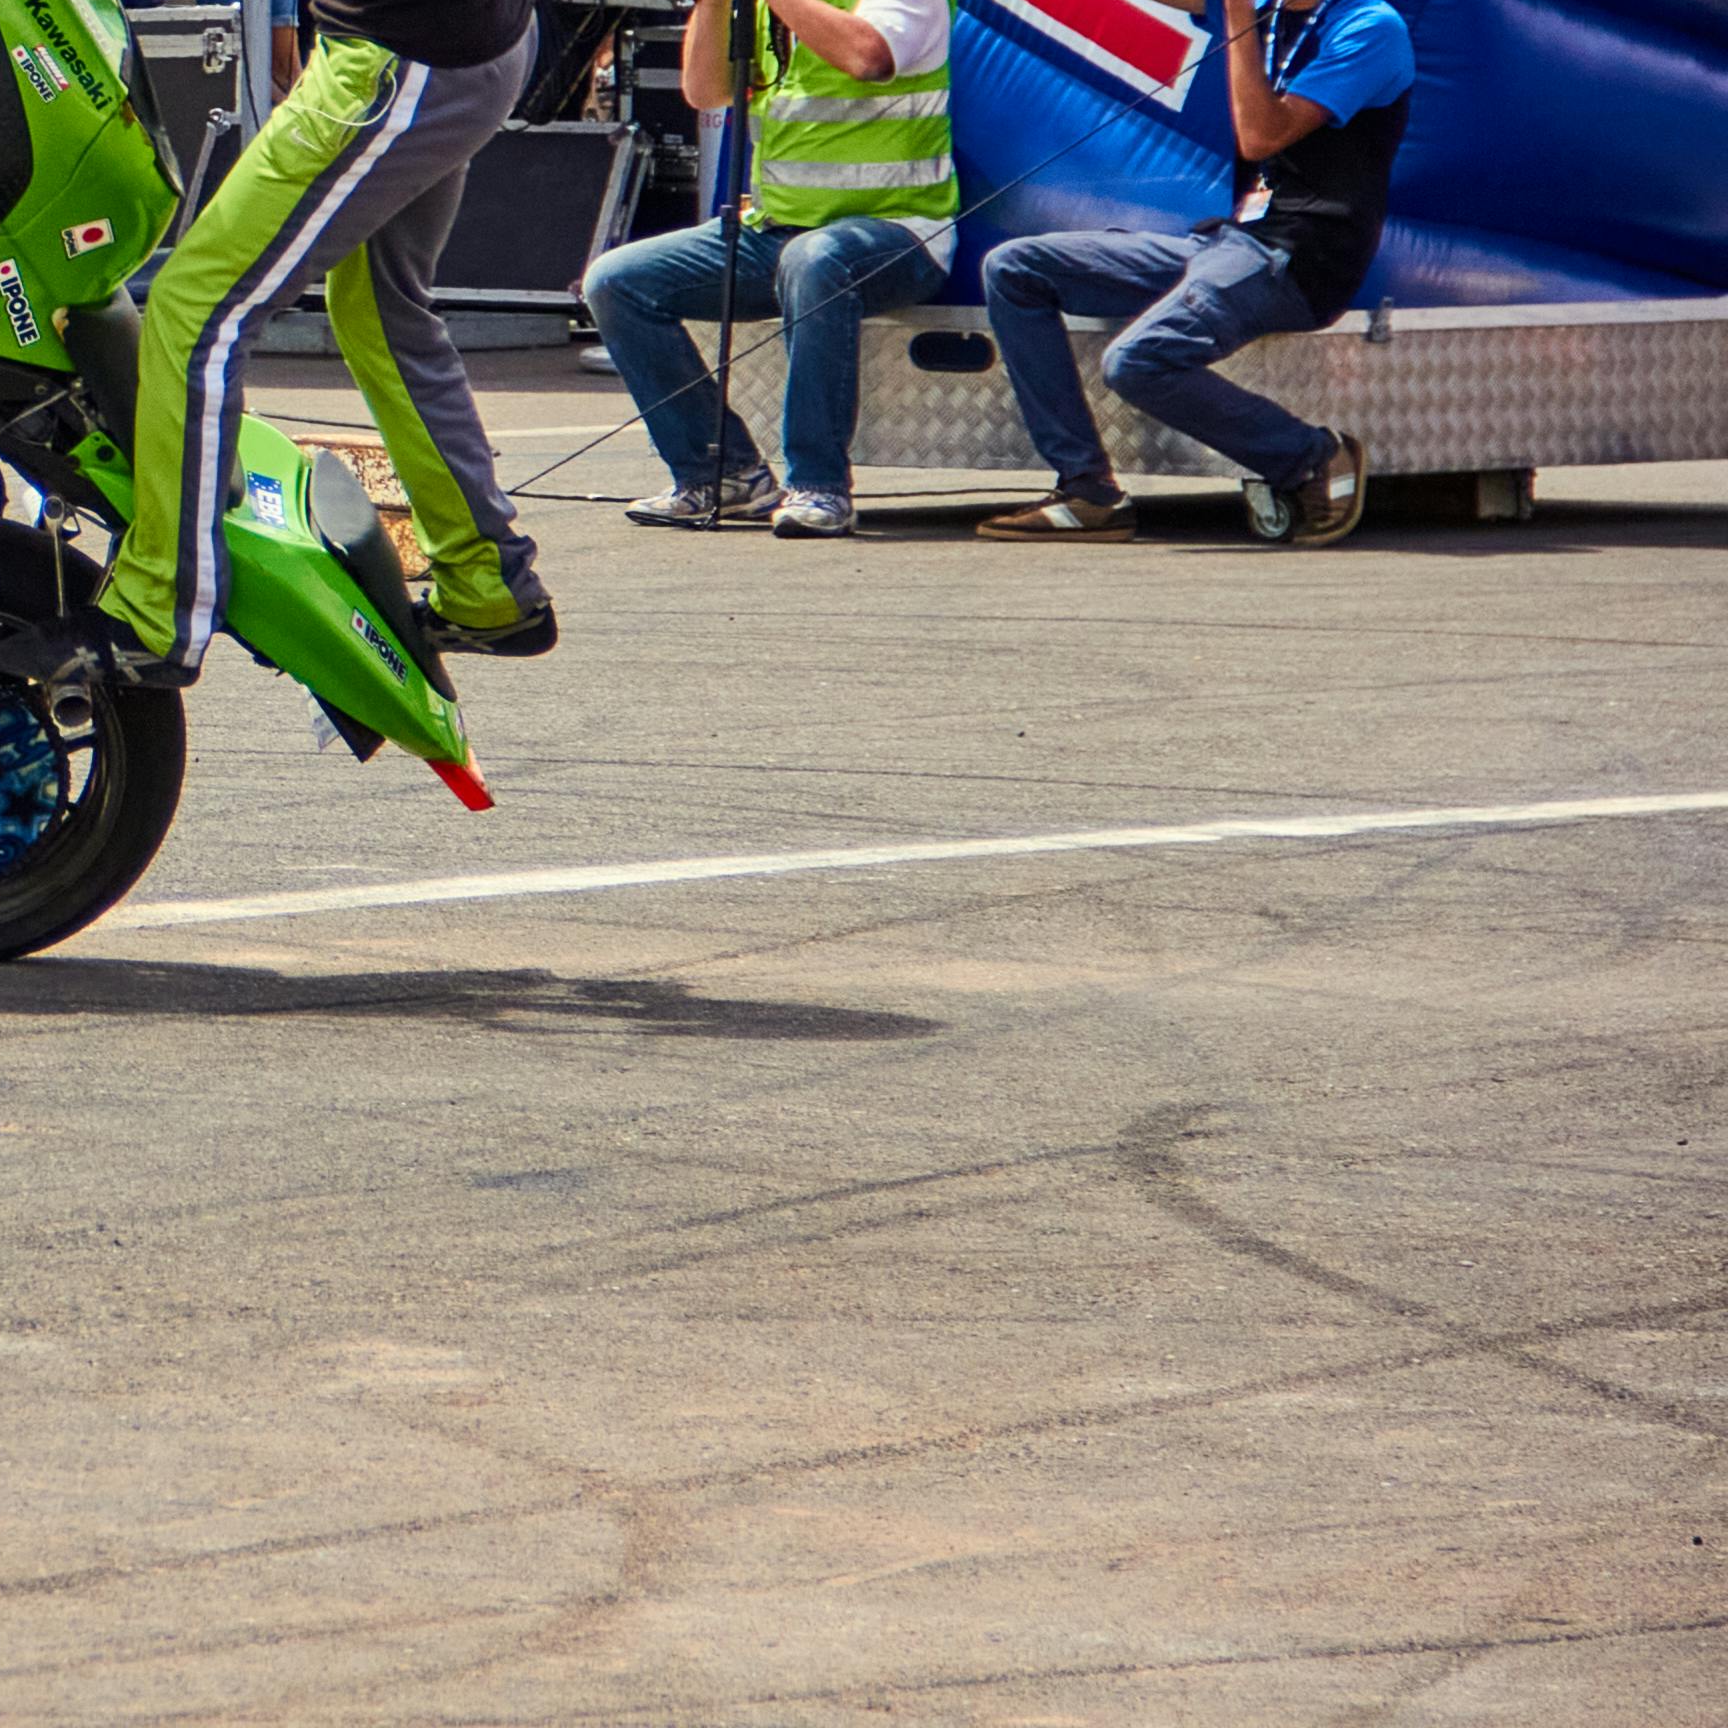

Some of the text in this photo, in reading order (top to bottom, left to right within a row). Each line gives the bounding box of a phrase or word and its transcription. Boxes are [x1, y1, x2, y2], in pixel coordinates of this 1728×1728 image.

[20, 58, 55, 103] IPONE
[0, 276, 38, 345] IPONE
[364, 624, 408, 682] IPONE
